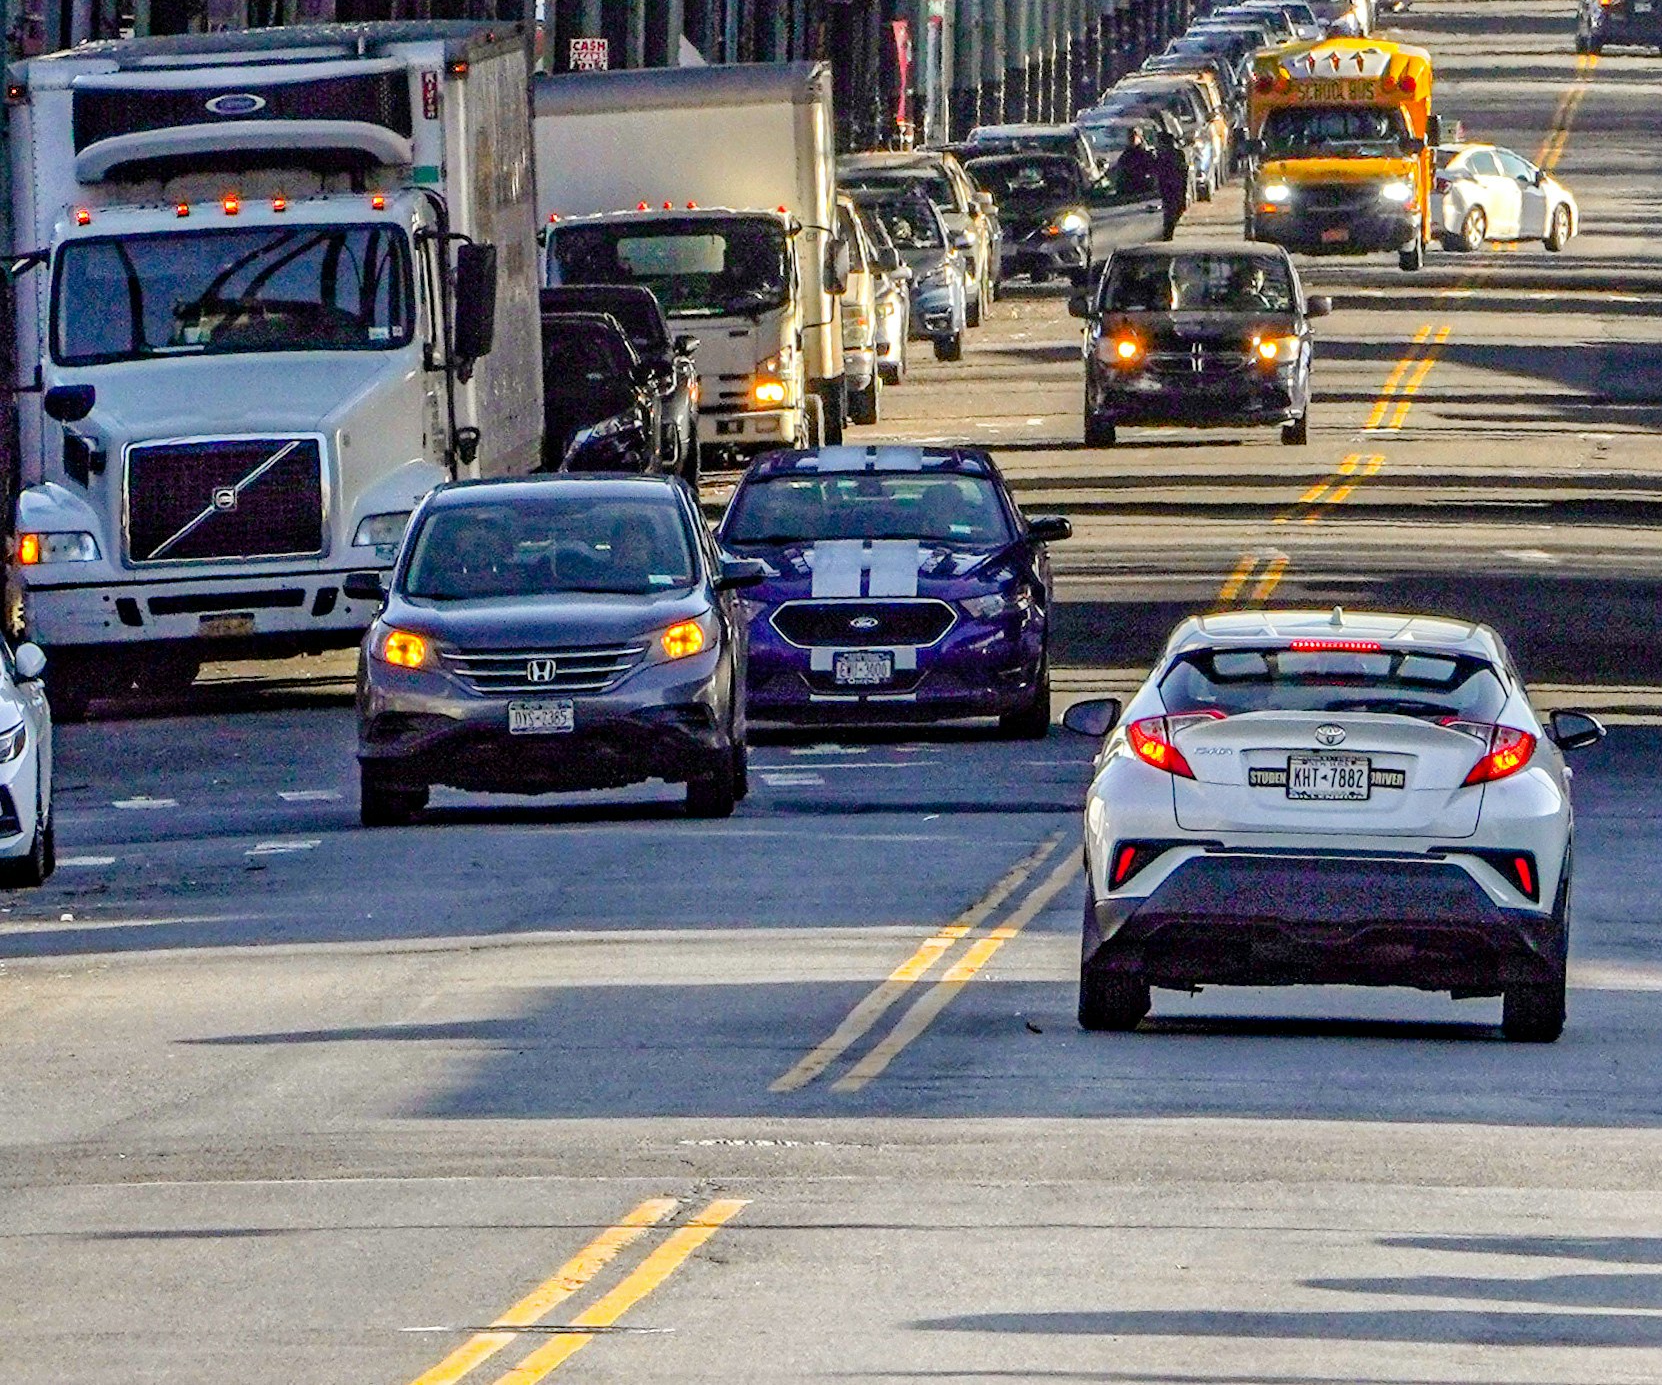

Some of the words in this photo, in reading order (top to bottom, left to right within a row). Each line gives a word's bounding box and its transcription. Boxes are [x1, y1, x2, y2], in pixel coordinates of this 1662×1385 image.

[1298, 81, 1348, 101] SCHOOL
[1350, 81, 1375, 101] BUS
[1250, 770, 1287, 784] STUDEN
